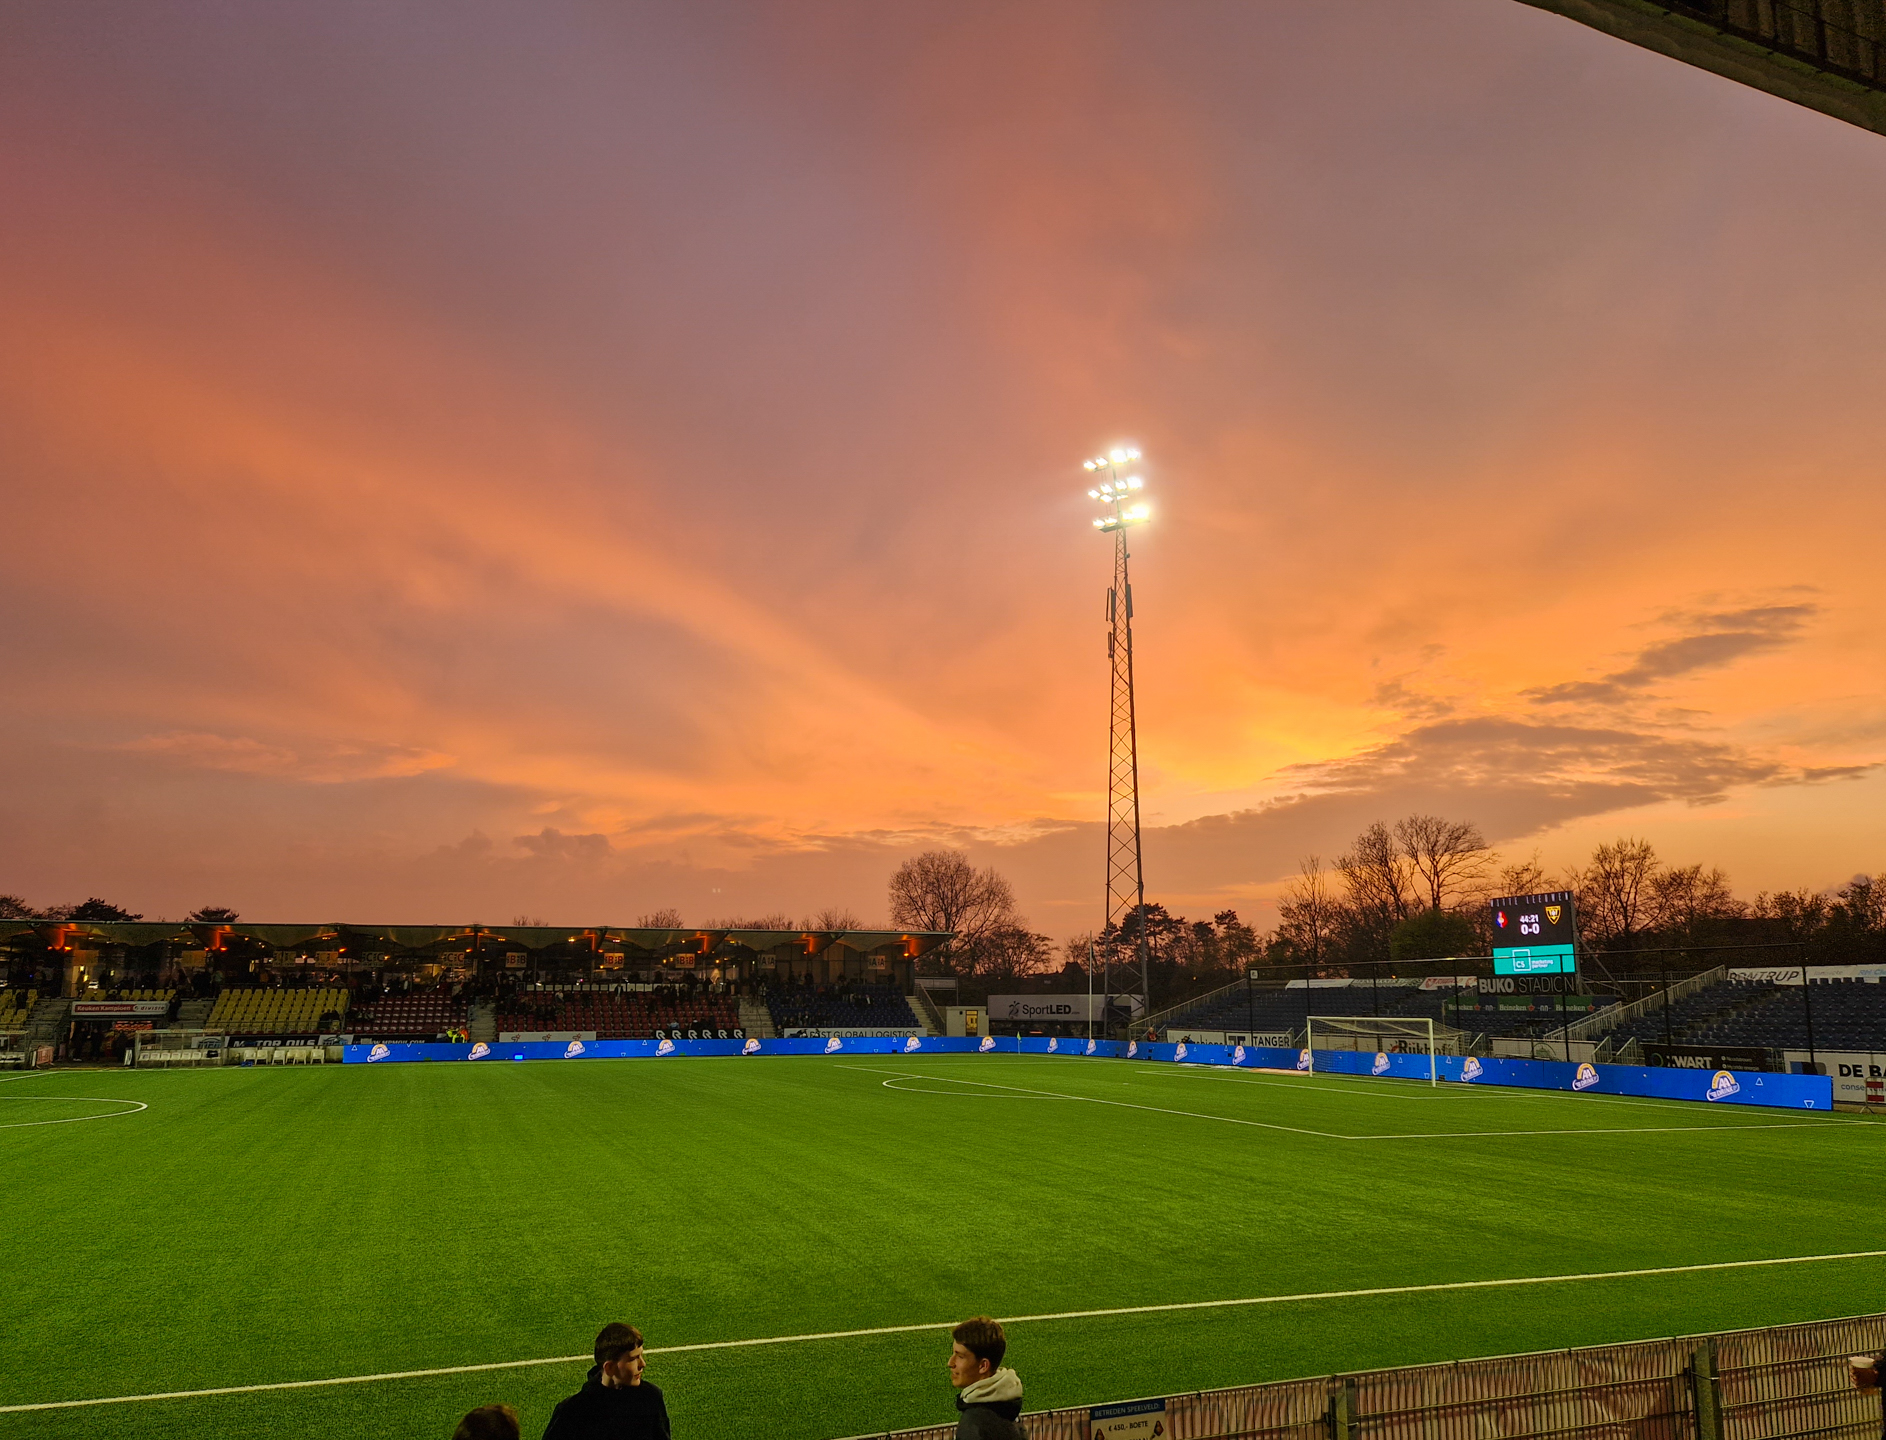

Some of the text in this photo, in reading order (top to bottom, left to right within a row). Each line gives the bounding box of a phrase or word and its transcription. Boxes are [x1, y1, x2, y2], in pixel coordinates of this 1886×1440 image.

[1520, 914, 1539, 923] 44:21
[1521, 923, 1540, 935] 0-0
[1479, 978, 1514, 993] BUKO
[1838, 1064, 1864, 1078] DE
[1095, 1408, 1126, 1417] BETREDEN
[1129, 1420, 1148, 1429] BOETE
